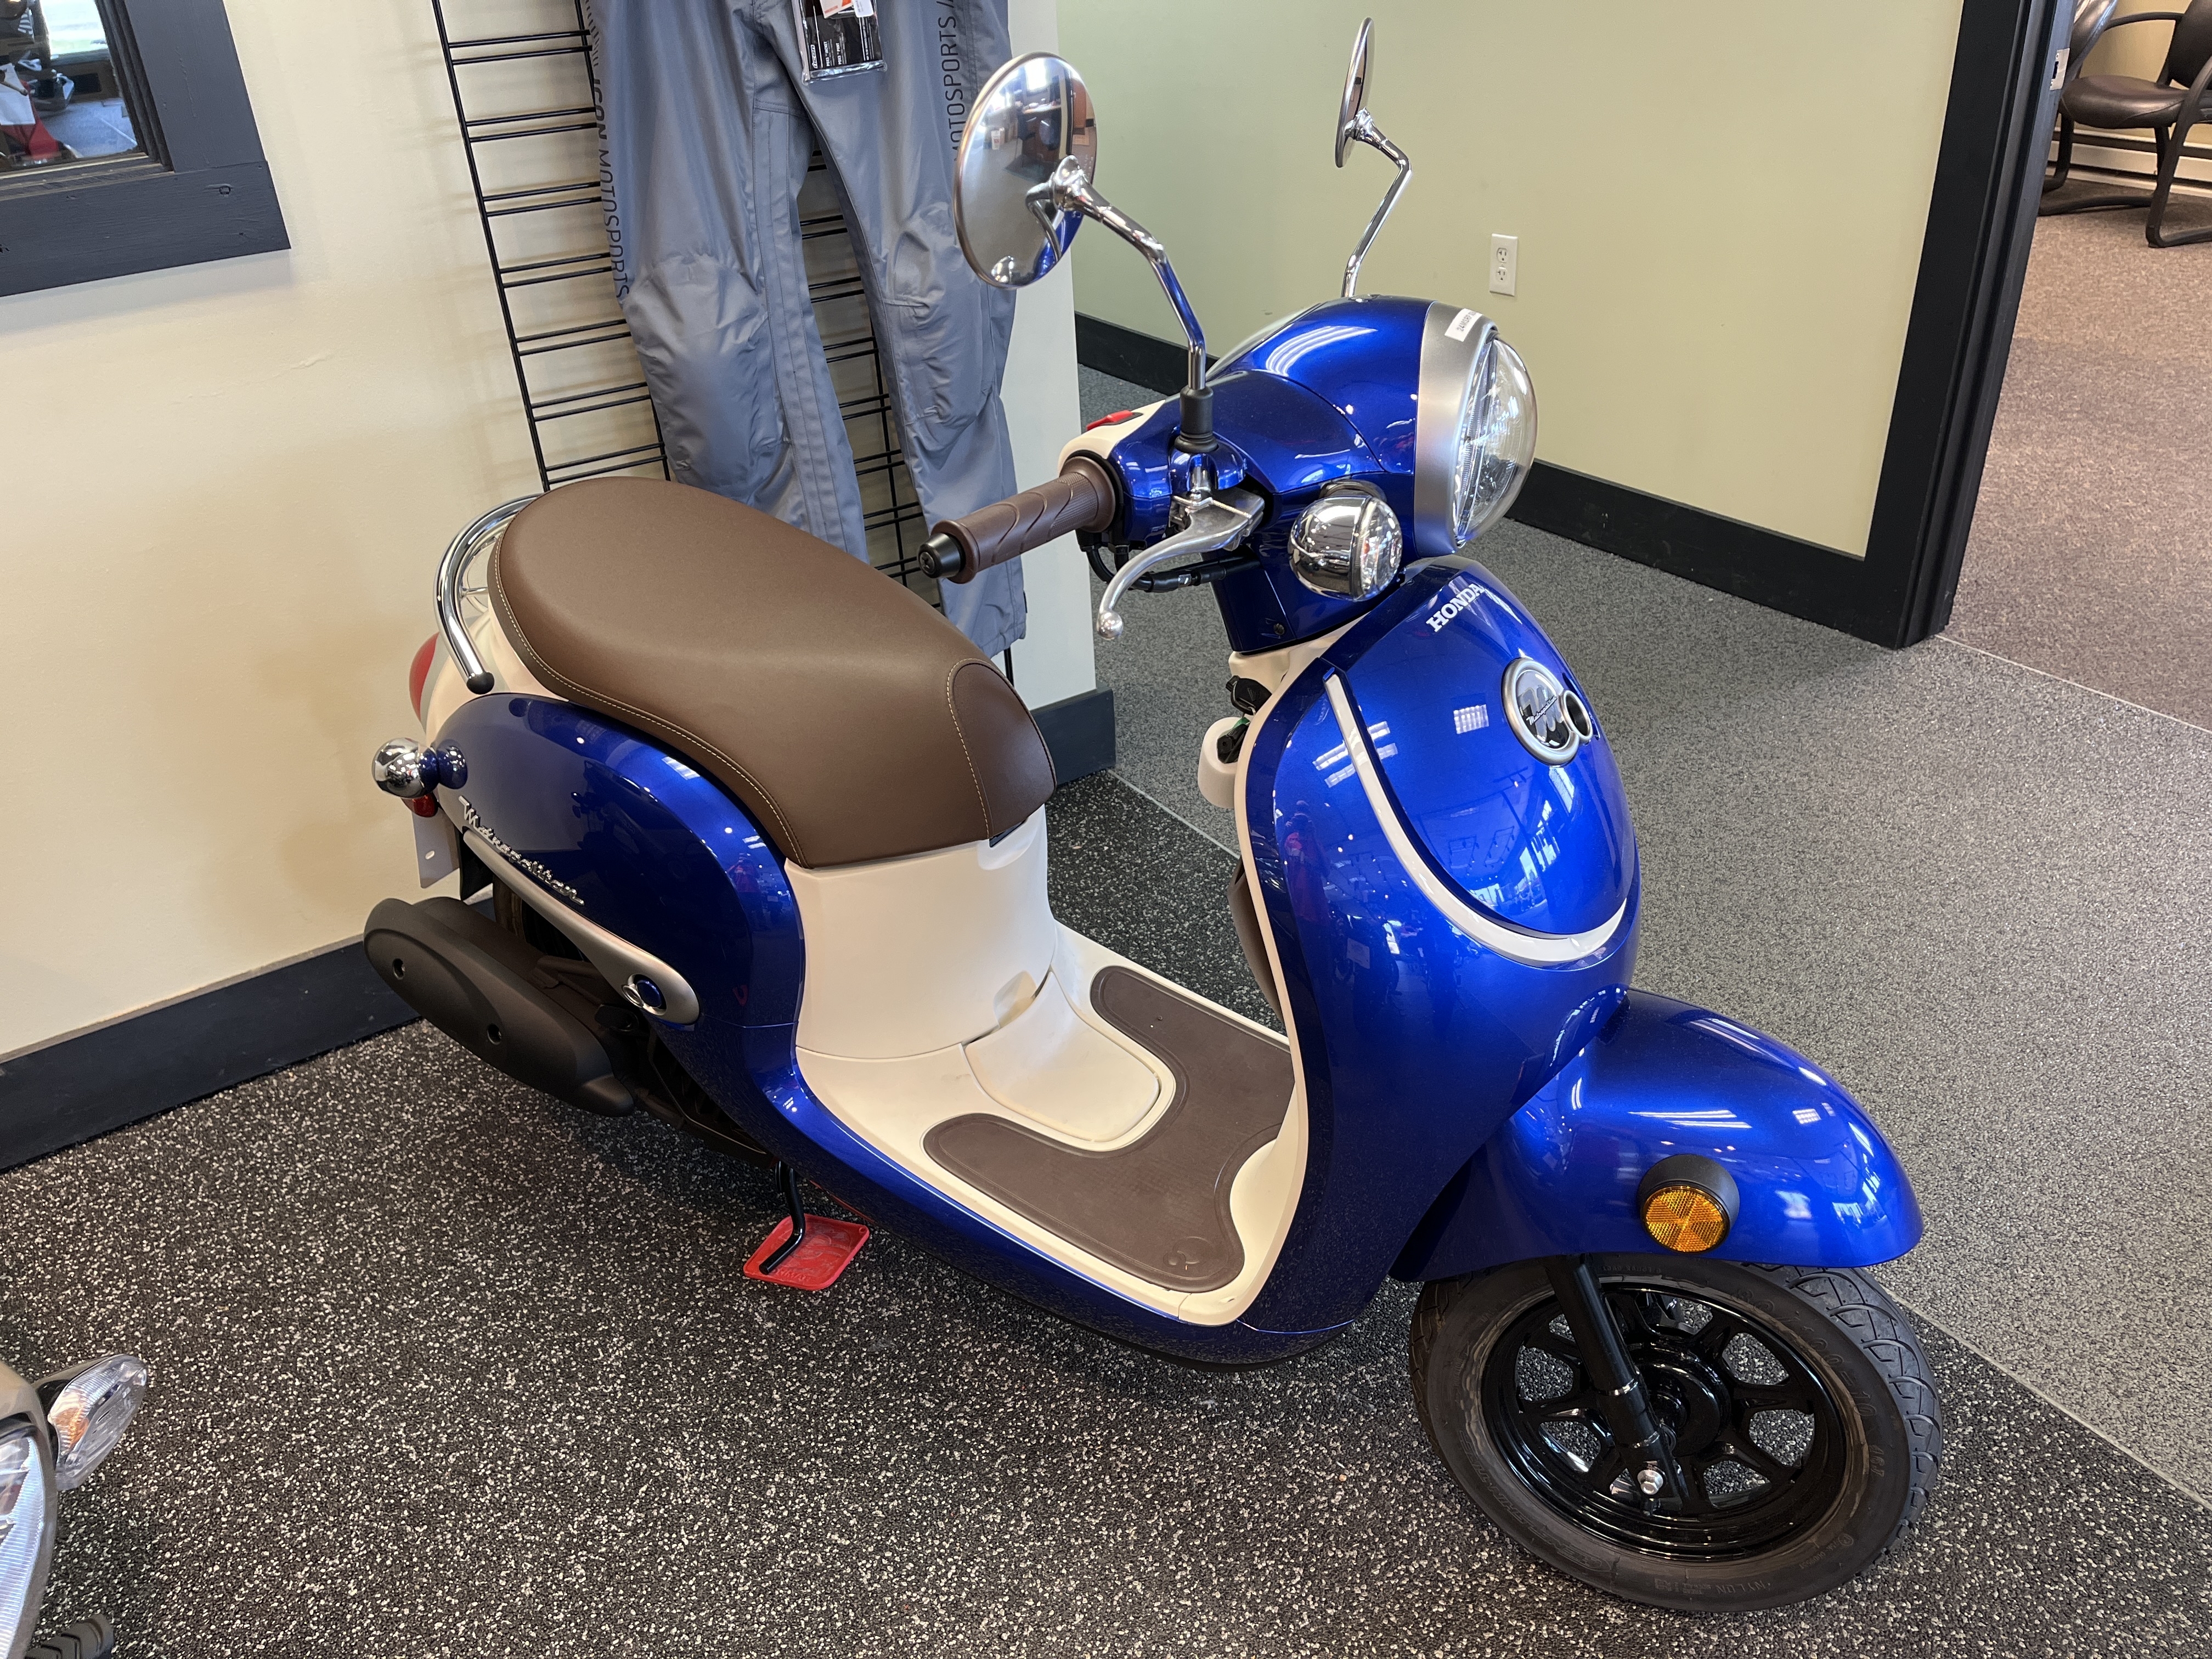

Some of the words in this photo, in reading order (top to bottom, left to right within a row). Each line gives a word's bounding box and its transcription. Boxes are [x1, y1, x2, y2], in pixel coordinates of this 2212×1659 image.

[599, 149, 629, 298] MOTOSPORTS
[1426, 583, 1485, 632] HONDA
[459, 795, 584, 905] Metropolitan
